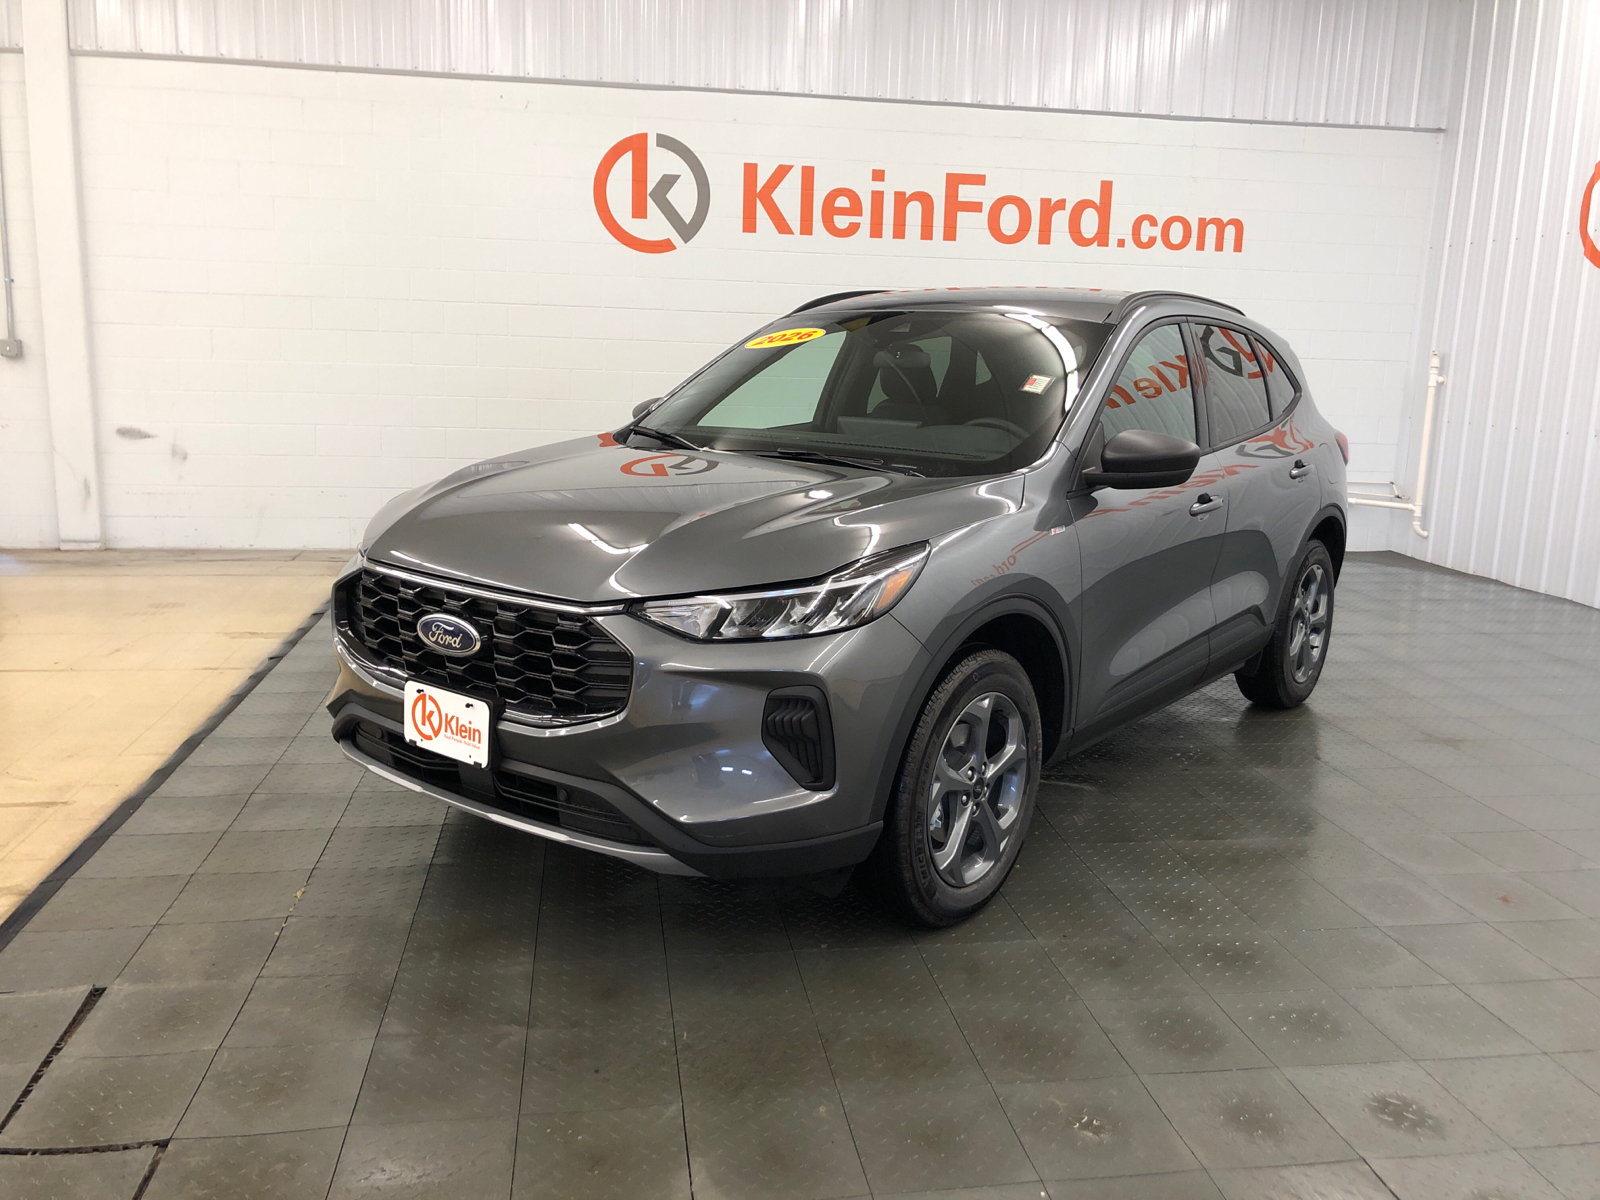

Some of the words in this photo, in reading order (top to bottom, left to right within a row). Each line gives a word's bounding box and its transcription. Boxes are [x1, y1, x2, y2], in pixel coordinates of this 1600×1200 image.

[740, 161, 1245, 254] KleinFord.com
[750, 330, 818, 347] 2026
[428, 621, 463, 649] Ford
[444, 713, 482, 744] Klein
[913, 810, 930, 880] MICHELIN
